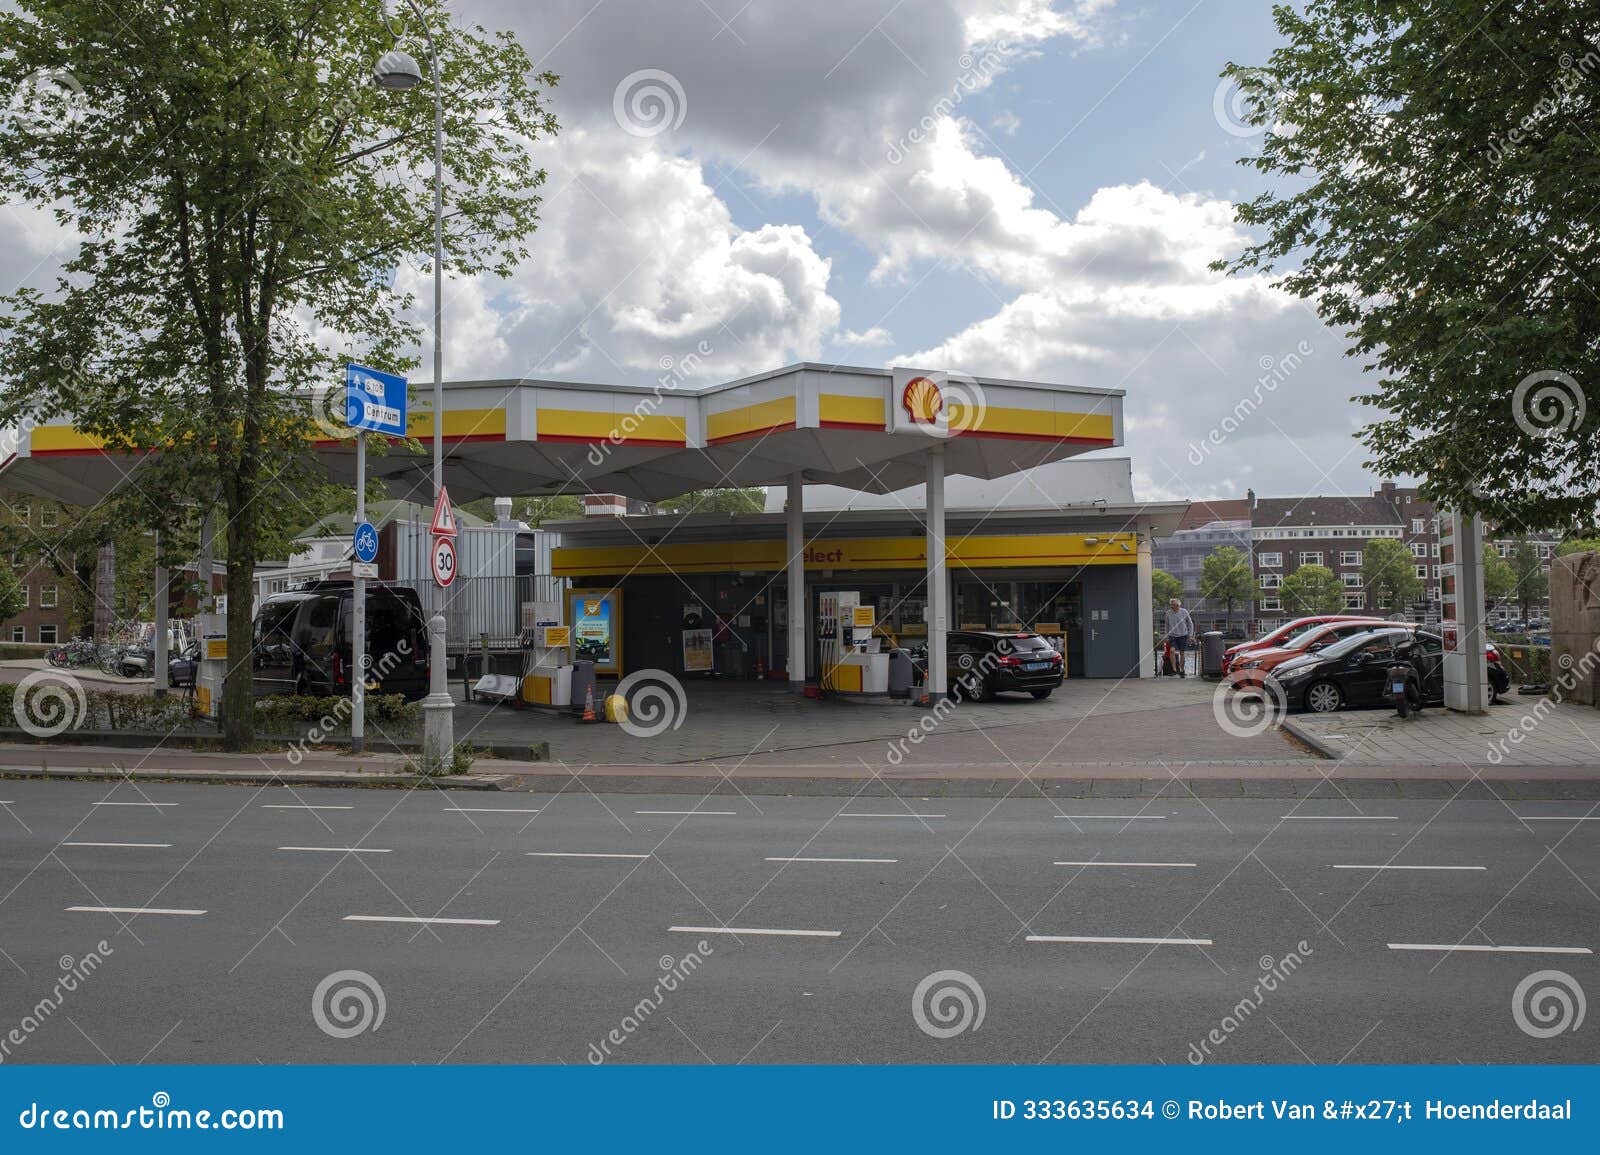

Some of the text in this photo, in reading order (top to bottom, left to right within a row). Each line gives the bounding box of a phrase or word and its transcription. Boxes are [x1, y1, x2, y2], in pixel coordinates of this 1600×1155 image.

[366, 405, 399, 422] Centrum
[438, 552, 452, 571] 30
[803, 547, 843, 563] elect
